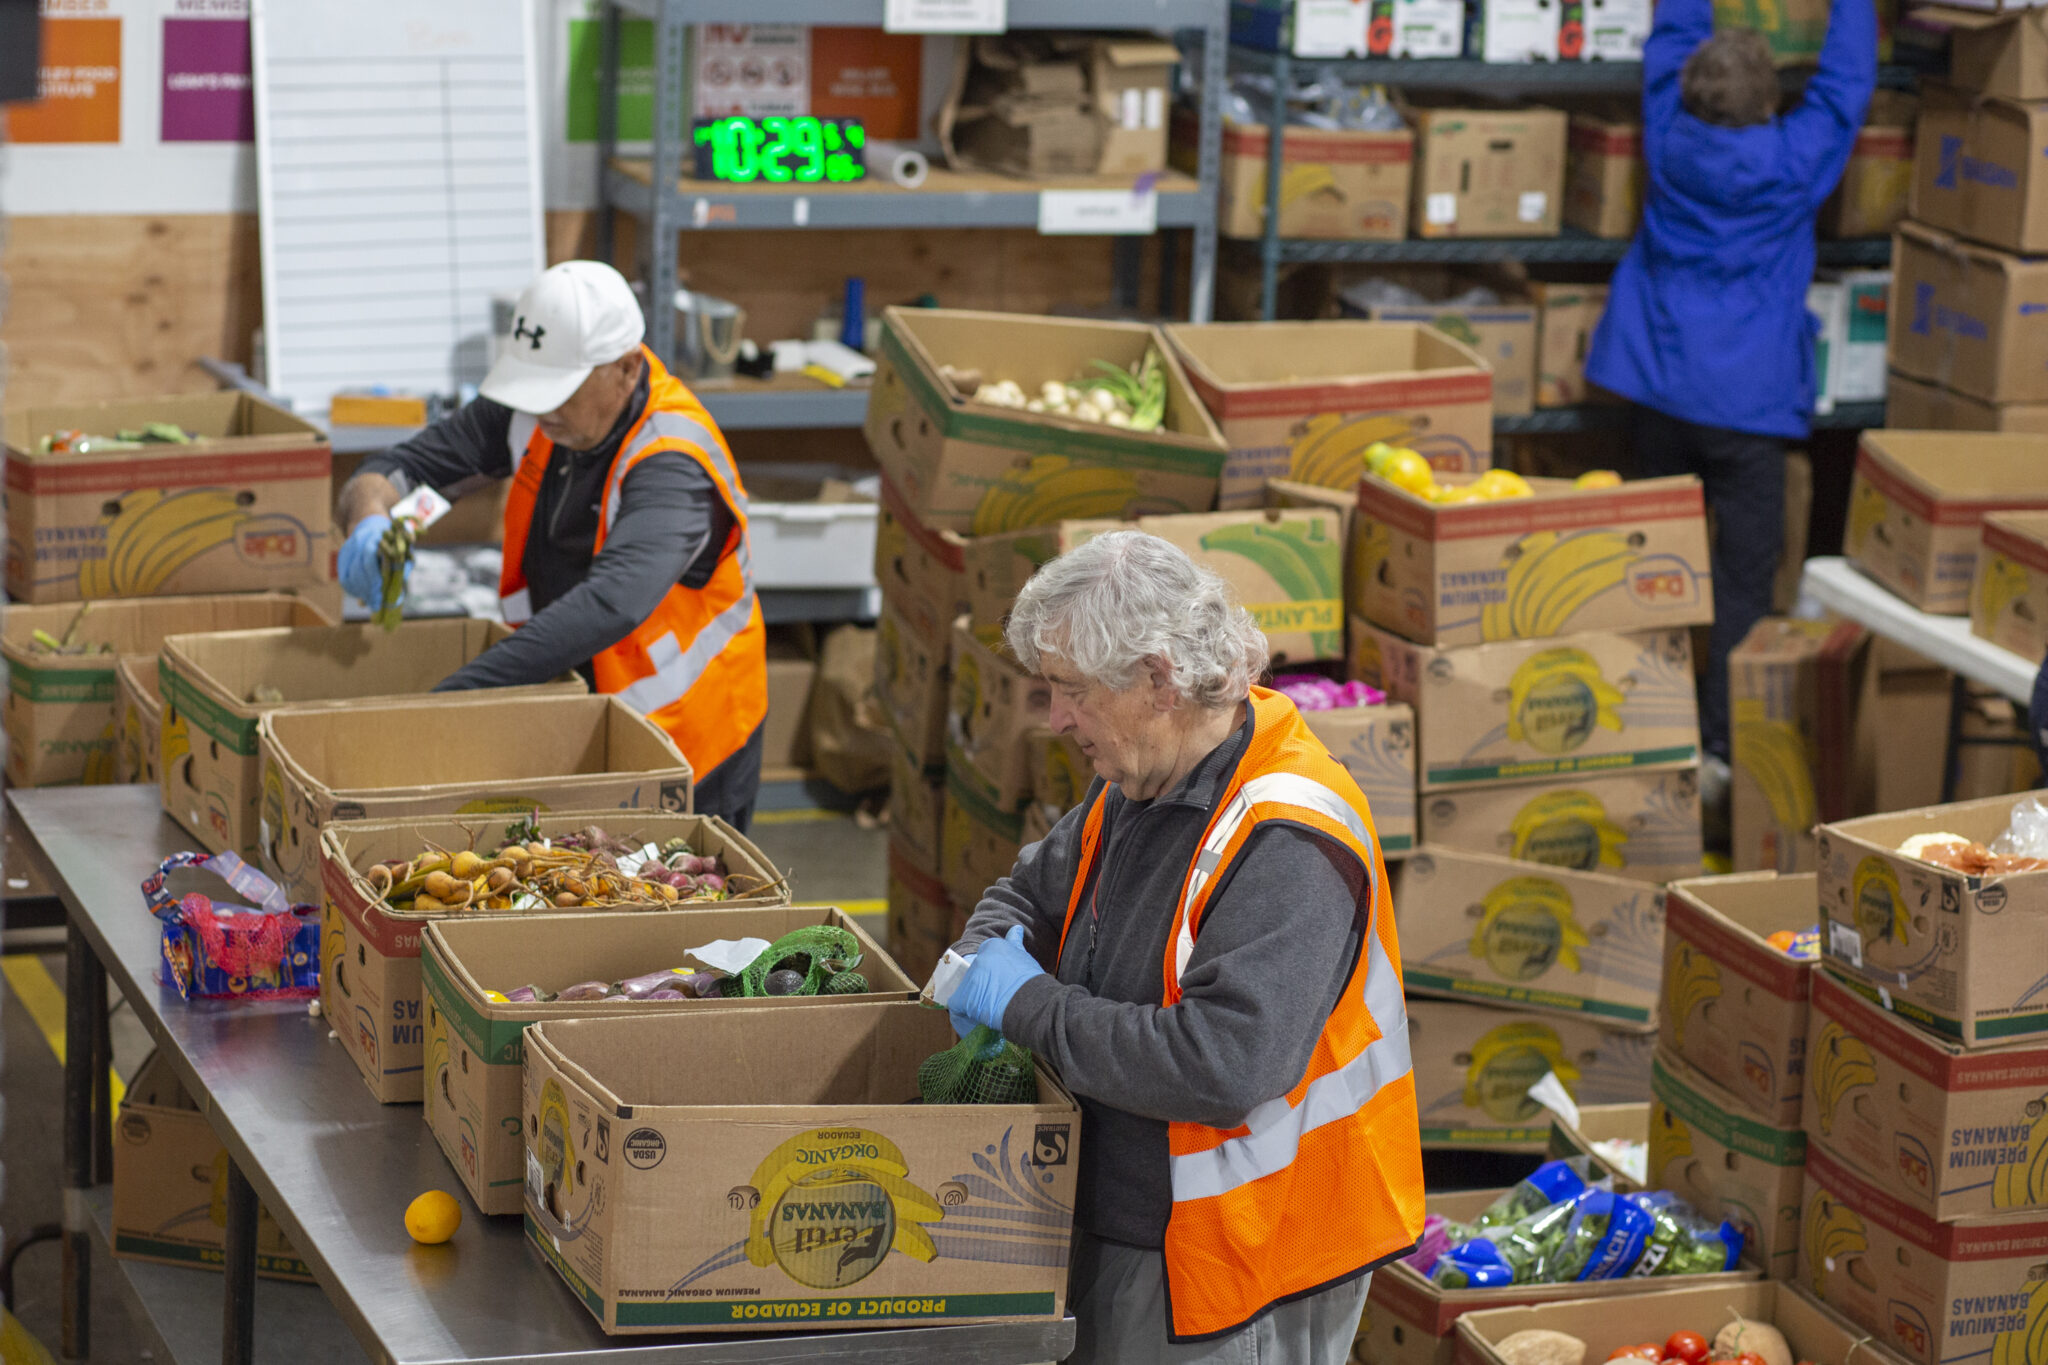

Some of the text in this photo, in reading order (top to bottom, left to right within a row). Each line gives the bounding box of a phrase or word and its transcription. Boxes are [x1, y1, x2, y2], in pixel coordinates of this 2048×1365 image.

[817, 1130, 861, 1139] ECUADOR
[1952, 1124, 2031, 1147] BANANAS
[632, 1150, 657, 1160] USDA
[796, 1142, 879, 1165] ORGANIC
[1949, 1146, 2028, 1169] PREMIUM
[782, 1202, 886, 1221] BANANAS
[618, 1287, 761, 1298] PREMIUM ORGANIC BANANAS
[731, 1299, 946, 1319] PRODUCT OF ECUADOR
[1952, 1293, 2031, 1316] BANANAS
[1949, 1314, 2028, 1337] PREMIUM
